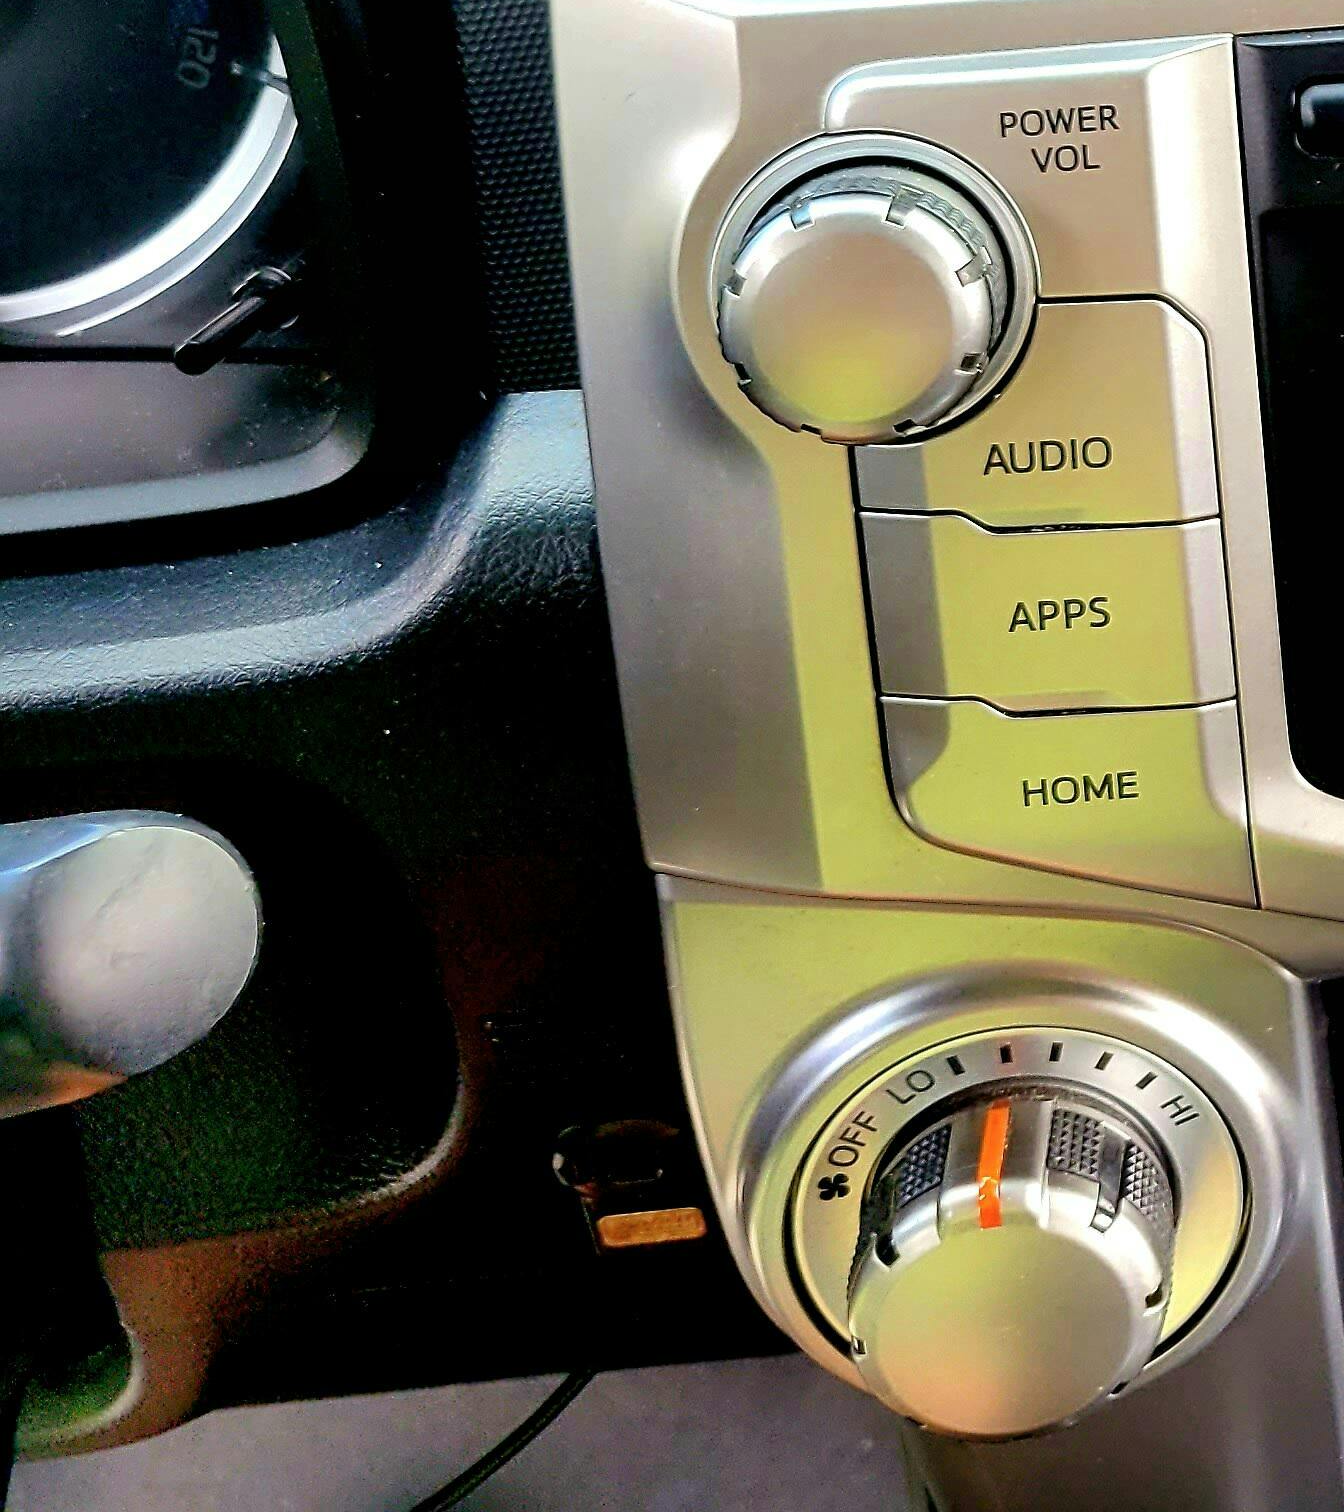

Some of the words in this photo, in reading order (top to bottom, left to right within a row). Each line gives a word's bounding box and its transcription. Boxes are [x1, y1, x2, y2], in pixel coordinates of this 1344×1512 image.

[176, 26, 220, 89] 120
[999, 104, 1121, 138] POWER
[1030, 143, 1102, 174] VOL
[982, 436, 1113, 476] AUDIO
[1007, 595, 1112, 633] APPS
[1021, 770, 1140, 808] HOME
[886, 1070, 936, 1106] LO
[1159, 1094, 1201, 1128] HI
[827, 1110, 879, 1168] OFF
